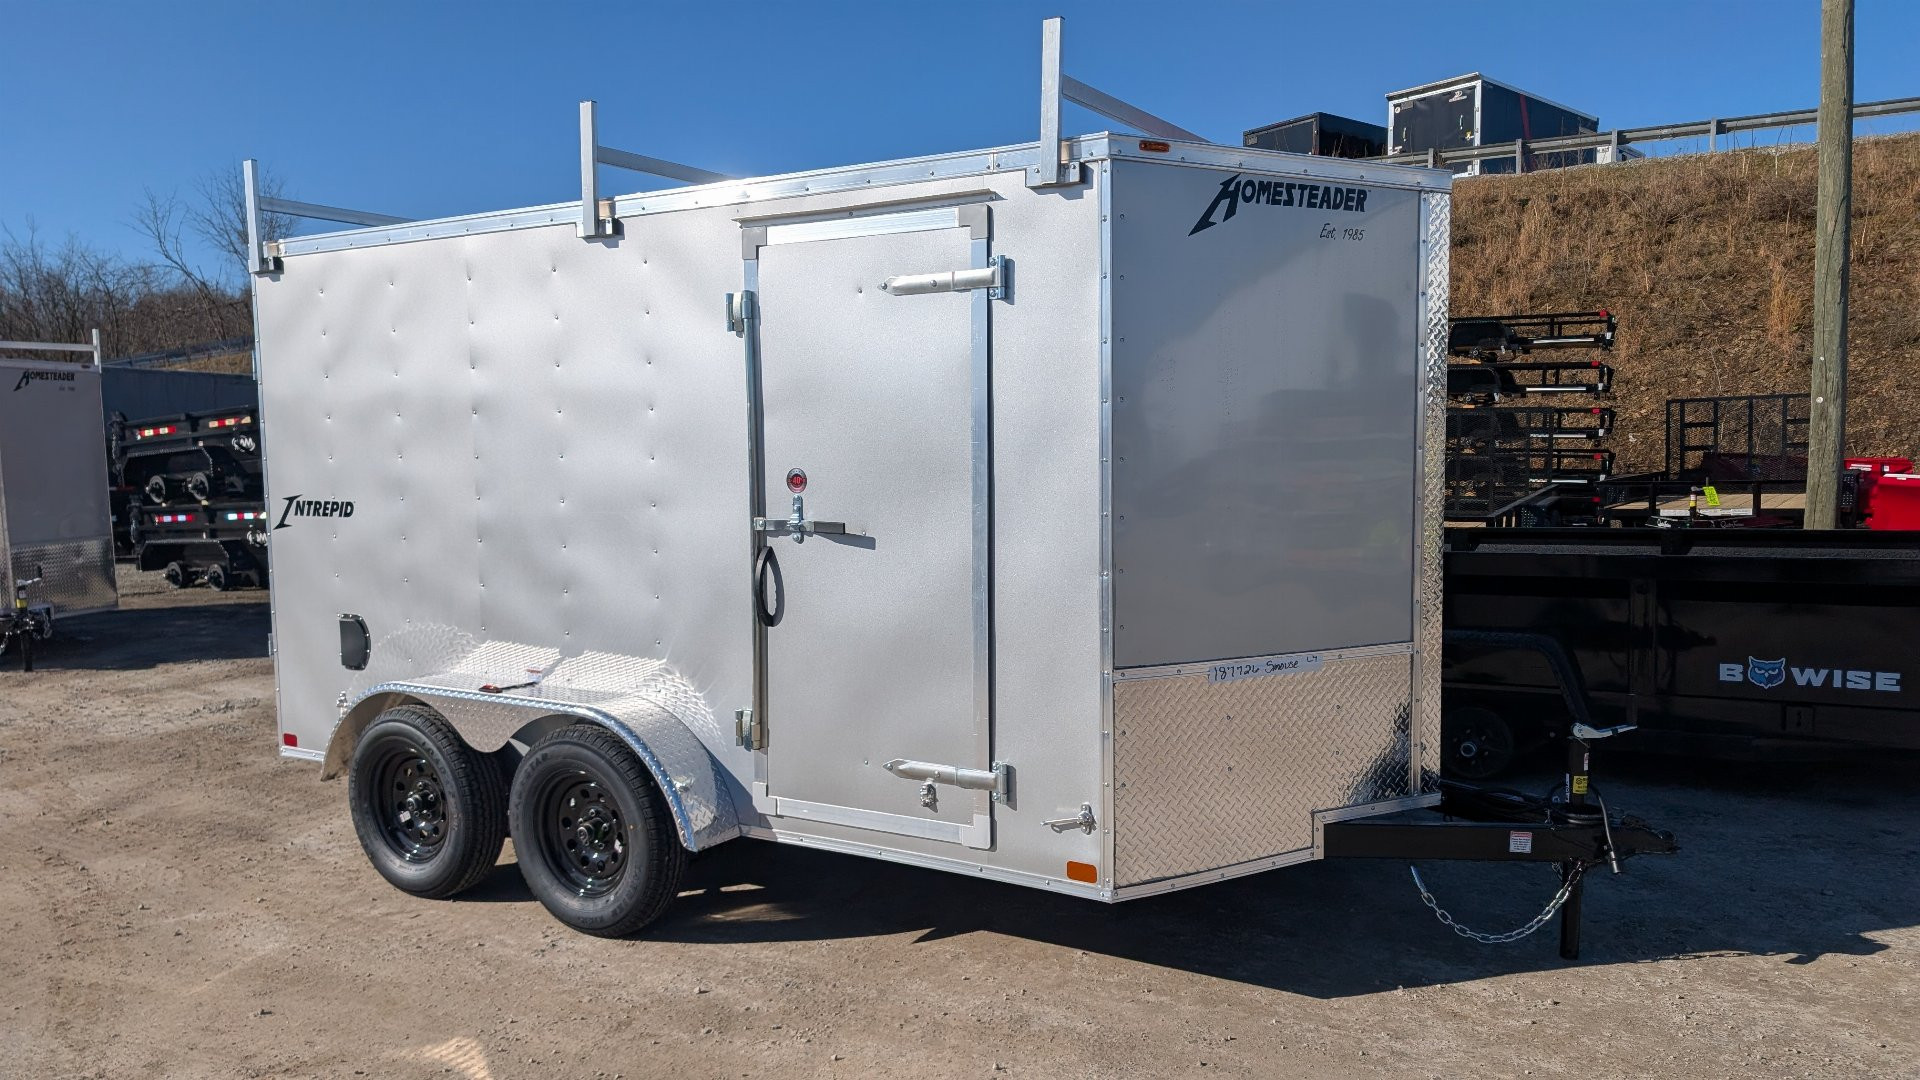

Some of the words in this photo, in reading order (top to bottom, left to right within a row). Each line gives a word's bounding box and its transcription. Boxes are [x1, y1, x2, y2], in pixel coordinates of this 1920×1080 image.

[1188, 173, 1368, 237] HOMESTEADER
[1320, 223, 1336, 240] Est.
[1342, 228, 1365, 241] 1985
[273, 494, 355, 530] INTREPID
